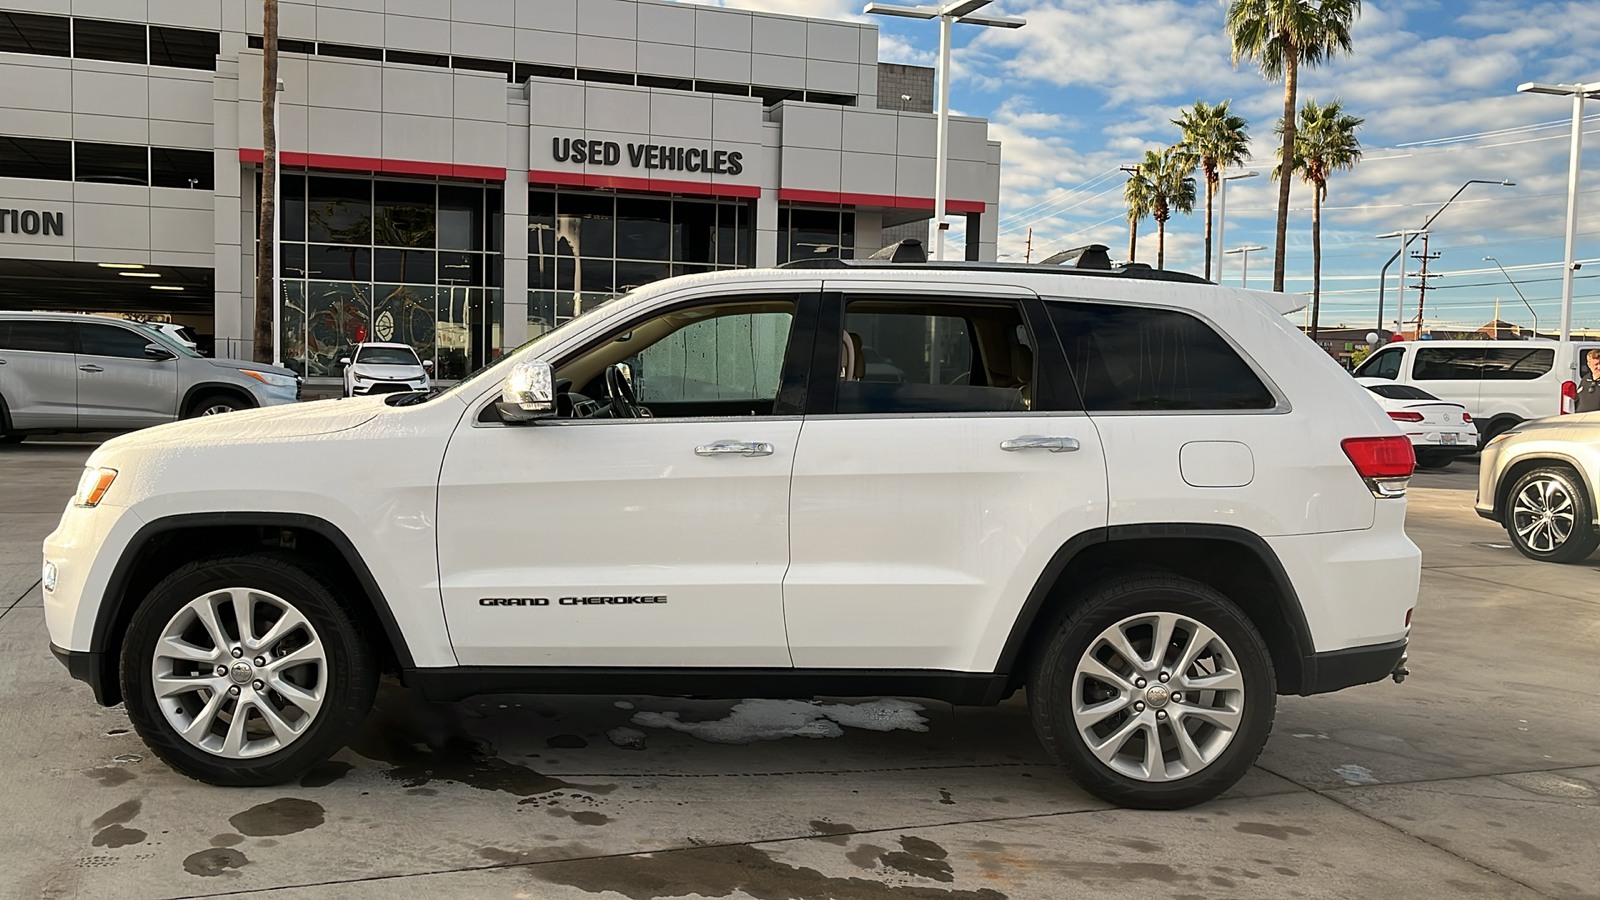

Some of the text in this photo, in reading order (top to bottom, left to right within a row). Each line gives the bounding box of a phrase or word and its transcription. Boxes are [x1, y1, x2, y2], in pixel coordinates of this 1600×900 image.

[552, 137, 743, 175] USED VEHICLES
[479, 595, 667, 606] GRAND CHEROKEE
